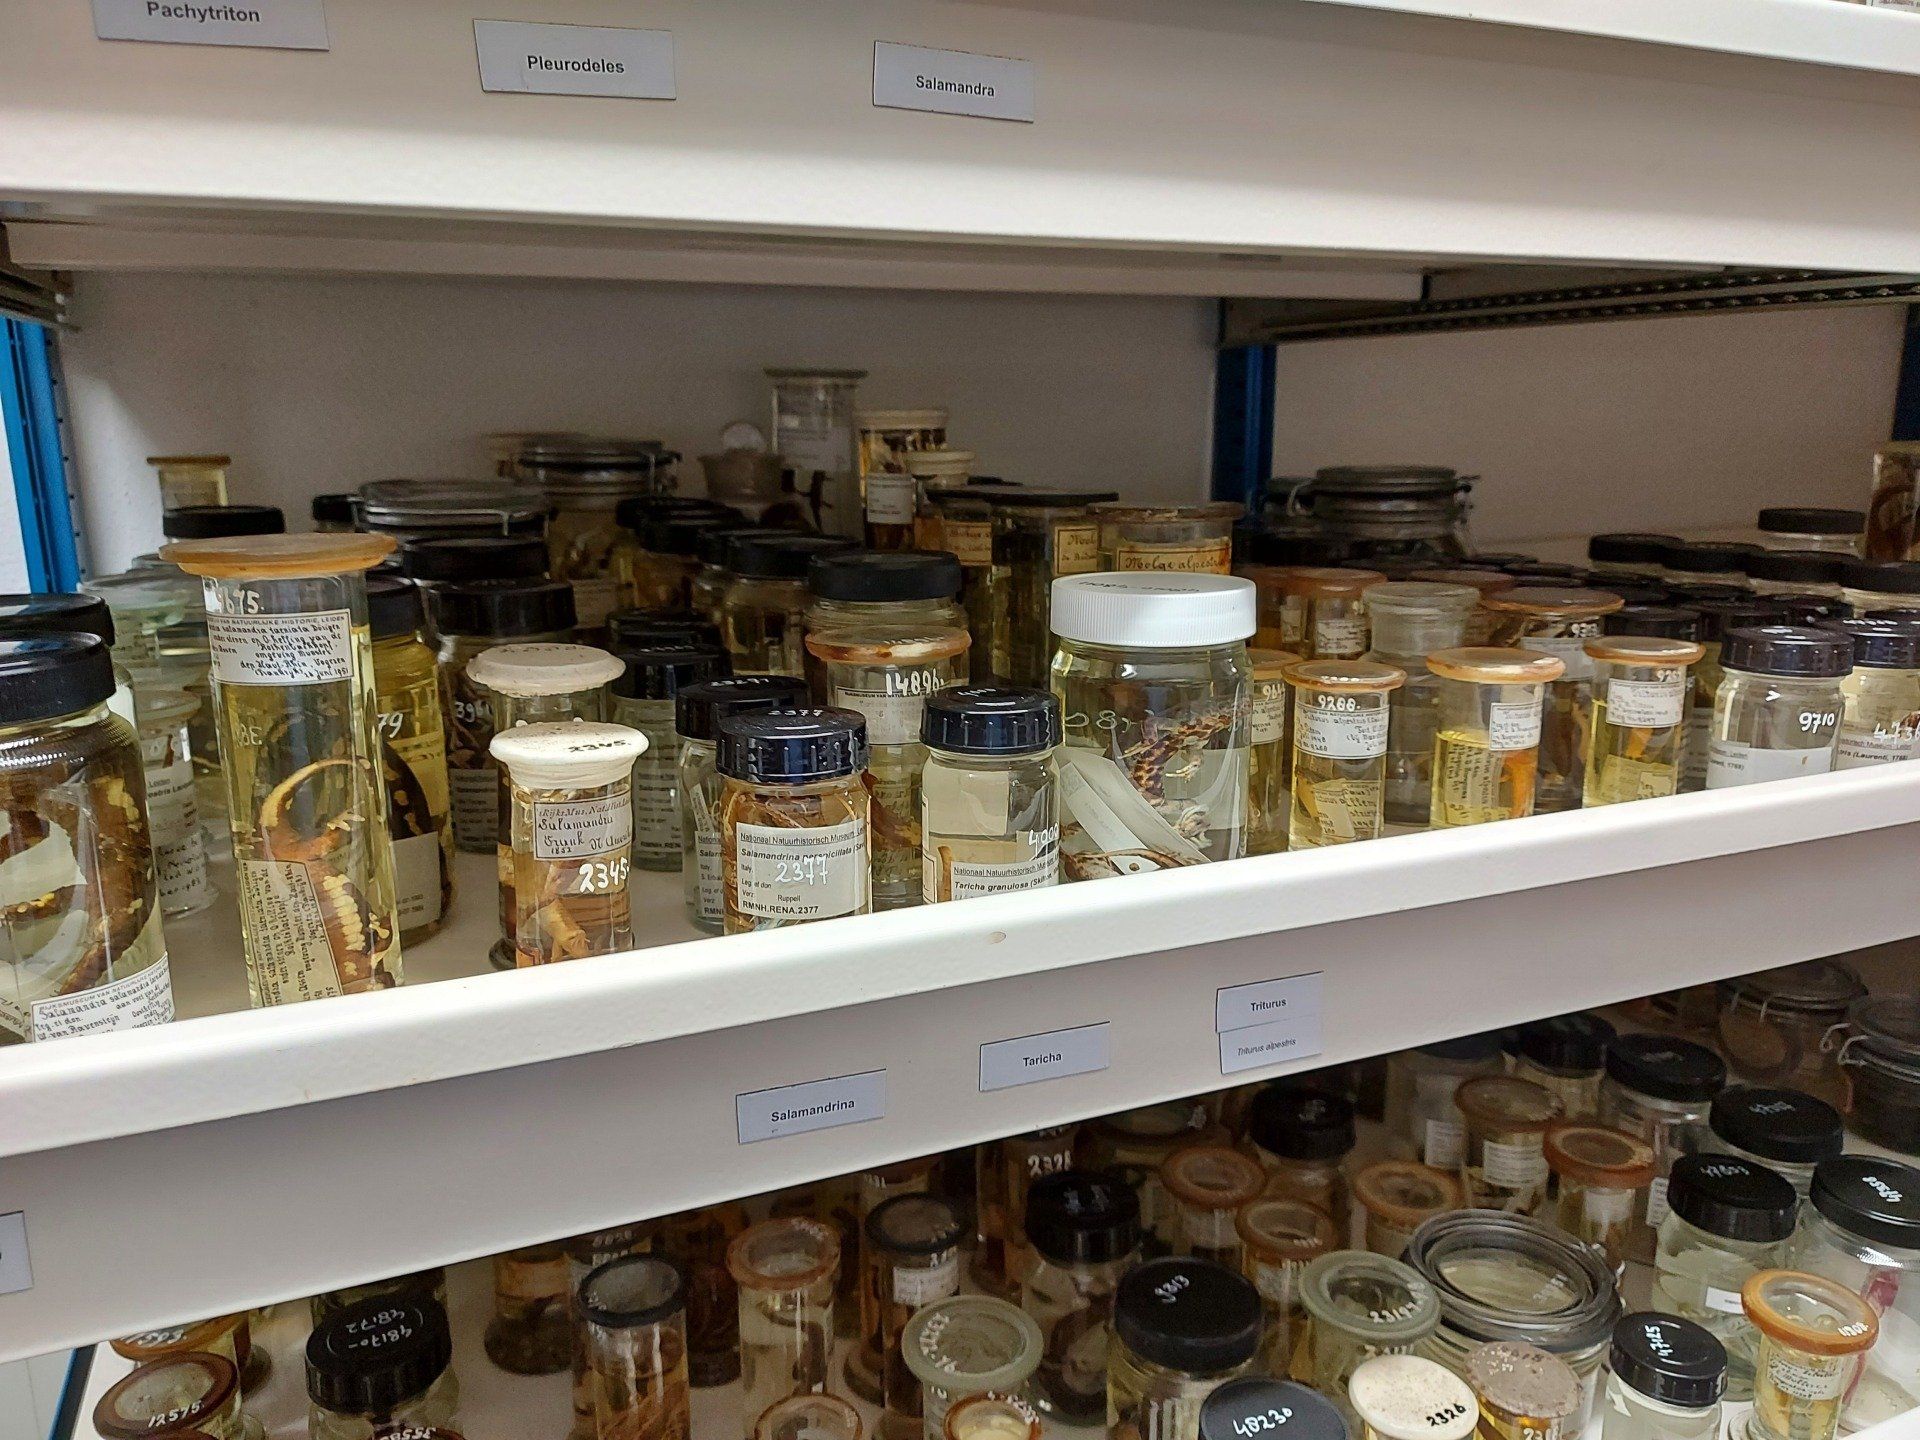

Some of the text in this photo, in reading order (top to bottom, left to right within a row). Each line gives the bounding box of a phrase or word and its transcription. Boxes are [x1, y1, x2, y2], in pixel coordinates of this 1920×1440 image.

[147, 1, 261, 23] Pachytriton
[527, 55, 625, 74] Pleurodeles
[916, 75, 995, 97] Salamandra
[1799, 712, 1835, 734] 9710
[740, 832, 771, 844] Nationaal
[772, 836, 829, 846] Natuurhistorisch
[741, 848, 800, 861] Salamandrina
[775, 856, 829, 886] 2377
[954, 867, 985, 876] Nationaal
[986, 866, 1036, 876] Natuurhistorisch
[954, 881, 985, 890] Taricha
[987, 882, 1029, 892] granulosa
[743, 901, 819, 915] RMNH.RENA.2377
[39, 1000, 108, 1020] Salamandra
[1251, 999, 1287, 1012] Triturus
[1237, 1038, 1297, 1056] Triturus alpestris
[1023, 1052, 1062, 1067] Taricha
[771, 1099, 855, 1122] Salamandrina
[1232, 1407, 1293, 1438] 48230
